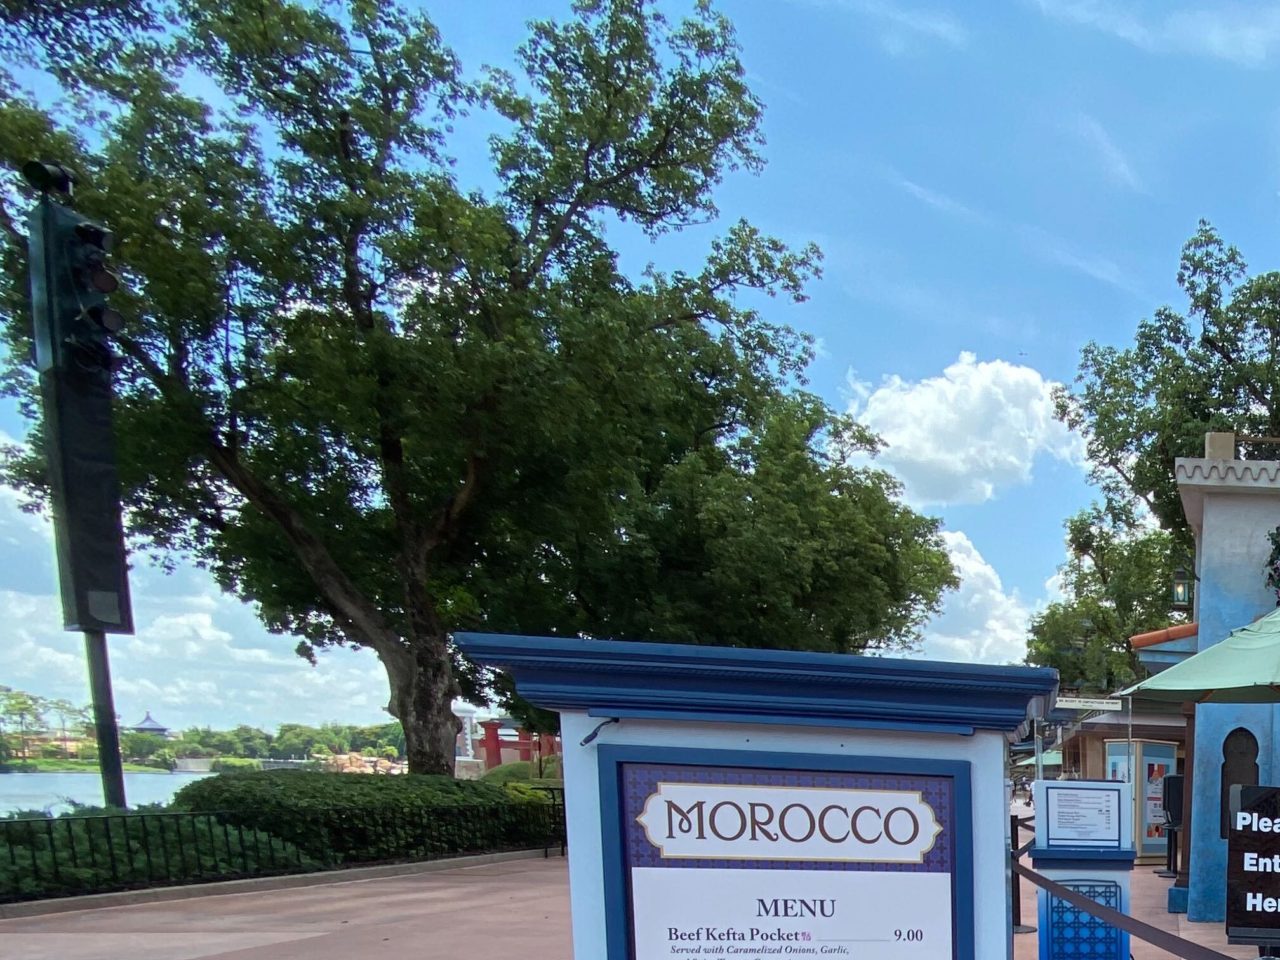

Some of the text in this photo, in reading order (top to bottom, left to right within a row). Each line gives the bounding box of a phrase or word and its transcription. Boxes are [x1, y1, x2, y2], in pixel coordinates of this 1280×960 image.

[664, 800, 919, 845] MOROCCO
[756, 898, 836, 918] MENU
[668, 927, 923, 942] Beef Kefta Pocket 9.00
[670, 946, 702, 954] Served
[703, 946, 724, 954] with
[726, 945, 782, 954] Caramelized
[784, 946, 818, 956] Onions,
